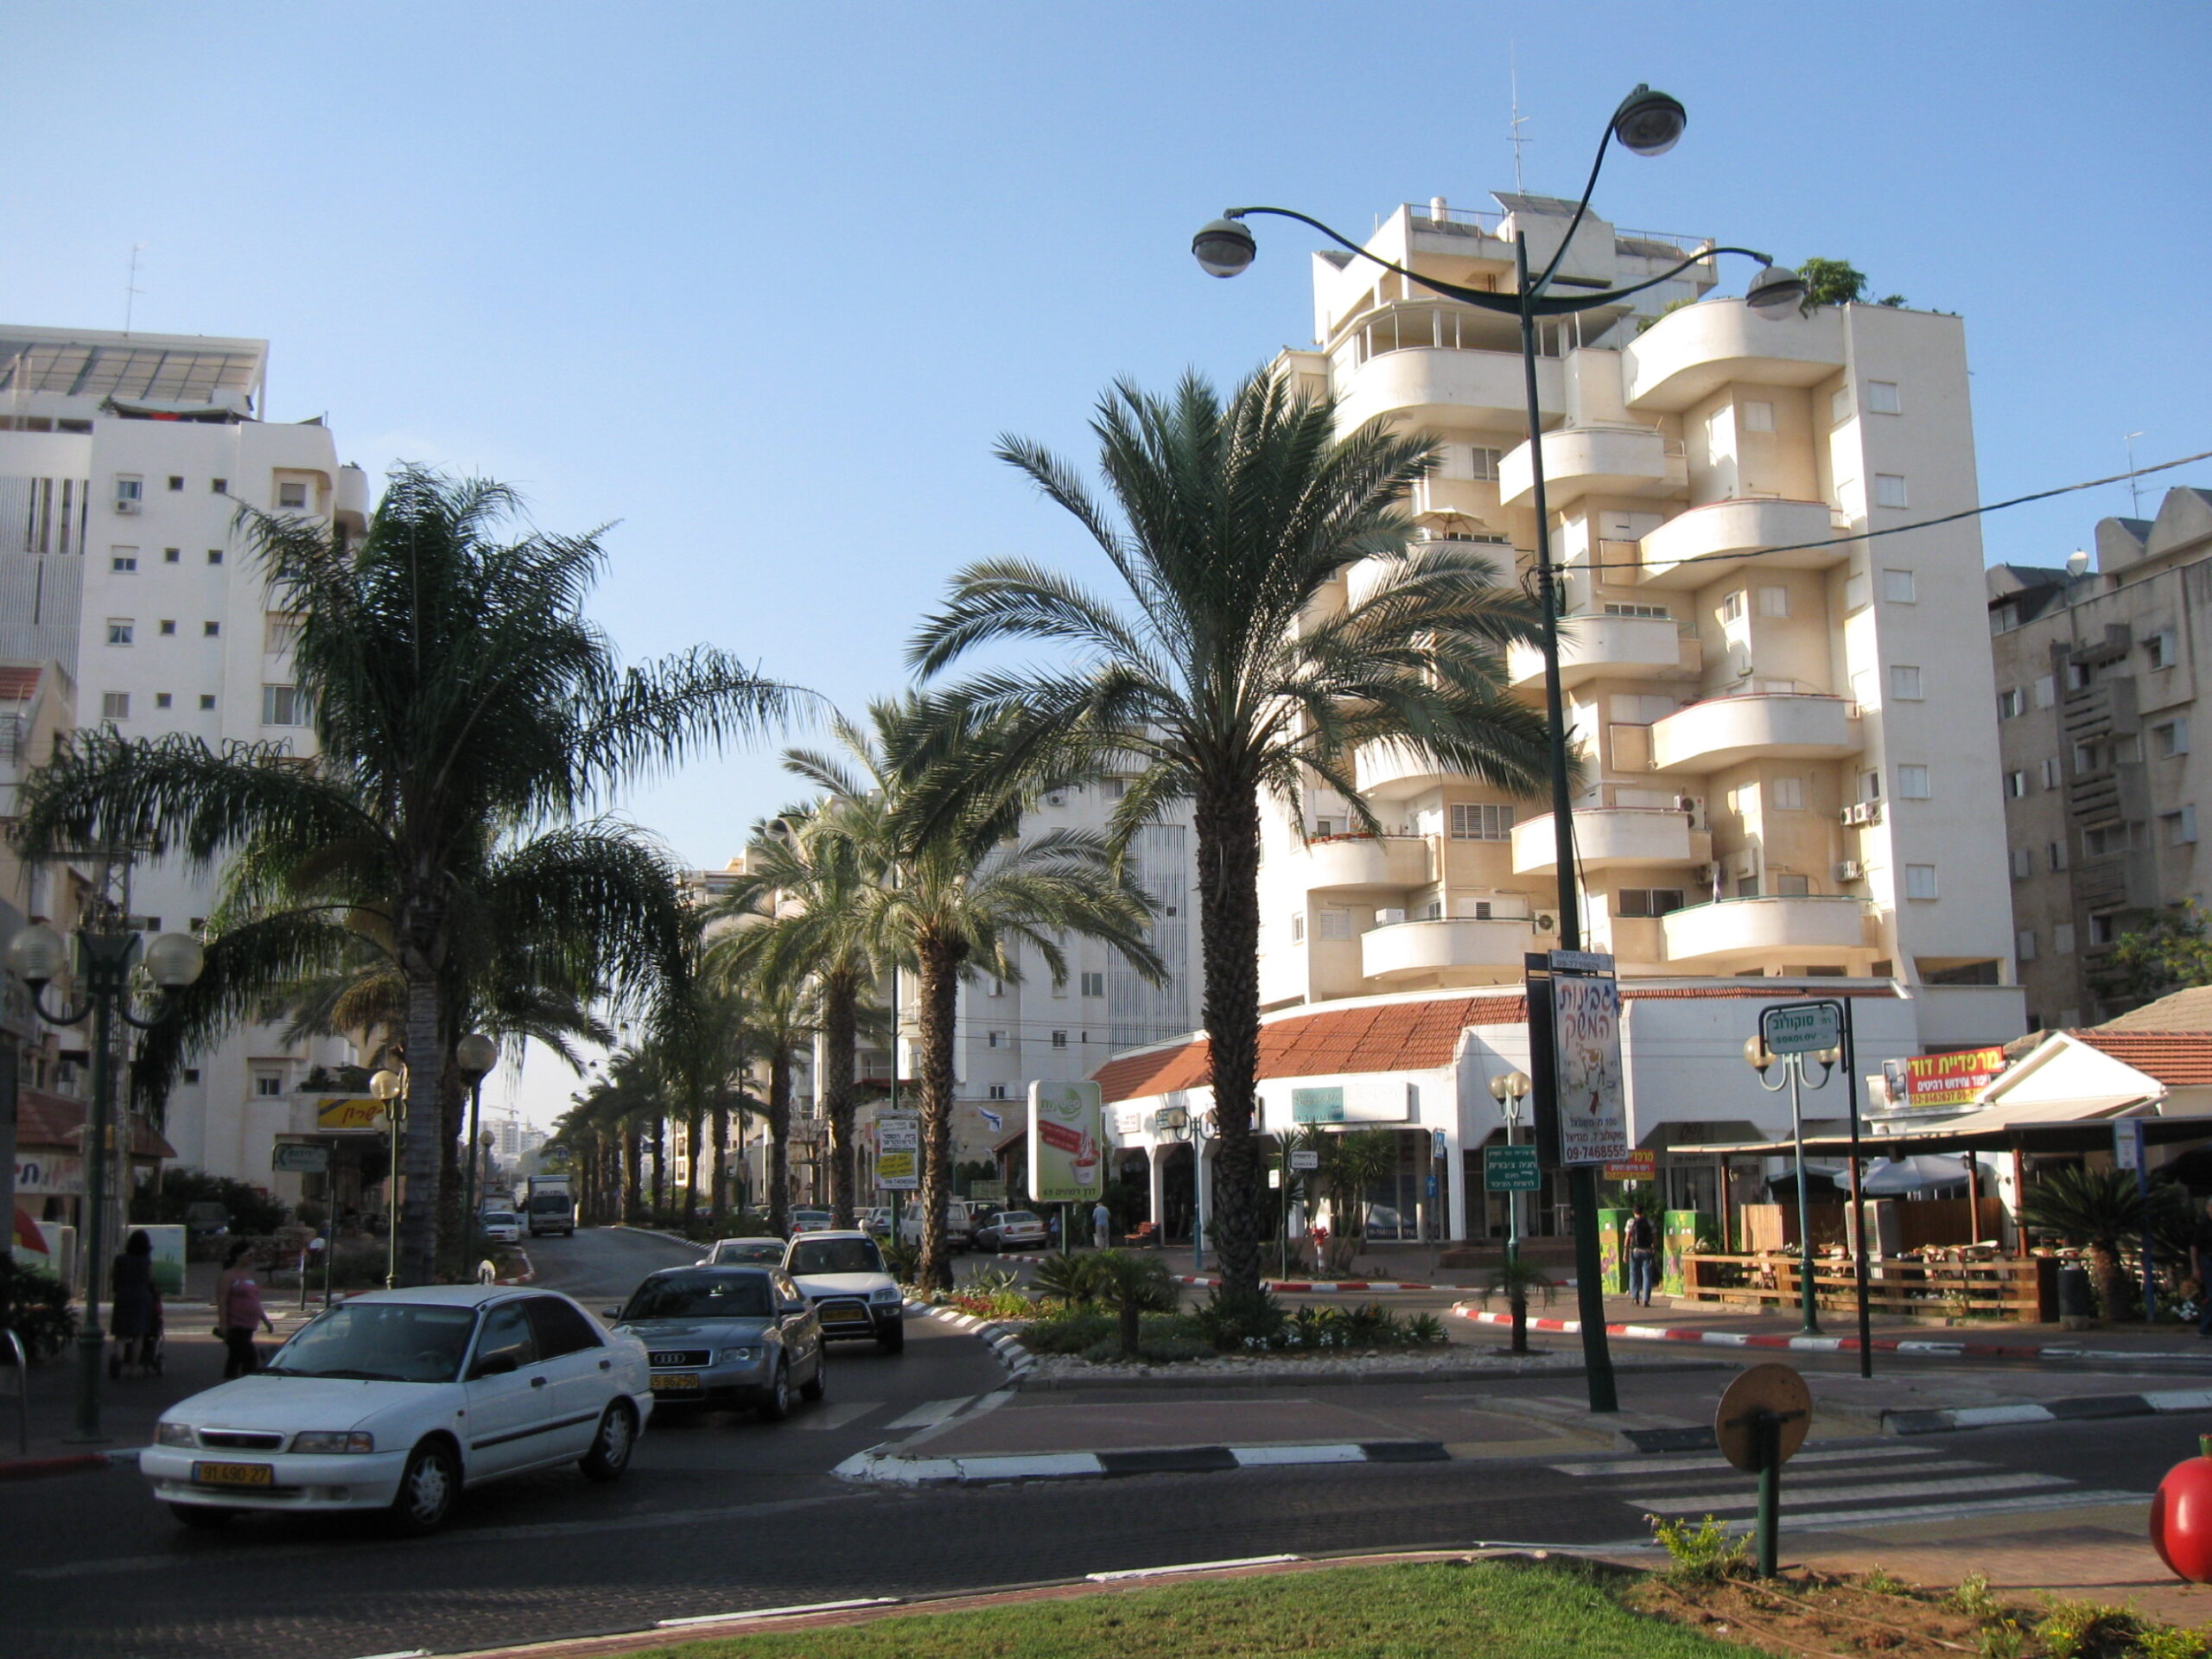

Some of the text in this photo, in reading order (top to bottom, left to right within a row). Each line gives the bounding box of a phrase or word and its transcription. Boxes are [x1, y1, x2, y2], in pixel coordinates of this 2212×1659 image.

[1560, 984, 1611, 1012] גבינות
[1773, 1014, 1814, 1031] סוקולוב
[1565, 1012, 1610, 1050] המשק
[1777, 1033, 1816, 1044] SOKOLOV
[1907, 1050, 1999, 1077] מרפדיית דודי
[1917, 1079, 1943, 1092] רהיטים
[1570, 1116, 1593, 1128] משמאל
[1567, 1145, 1625, 1160] 09-7468555
